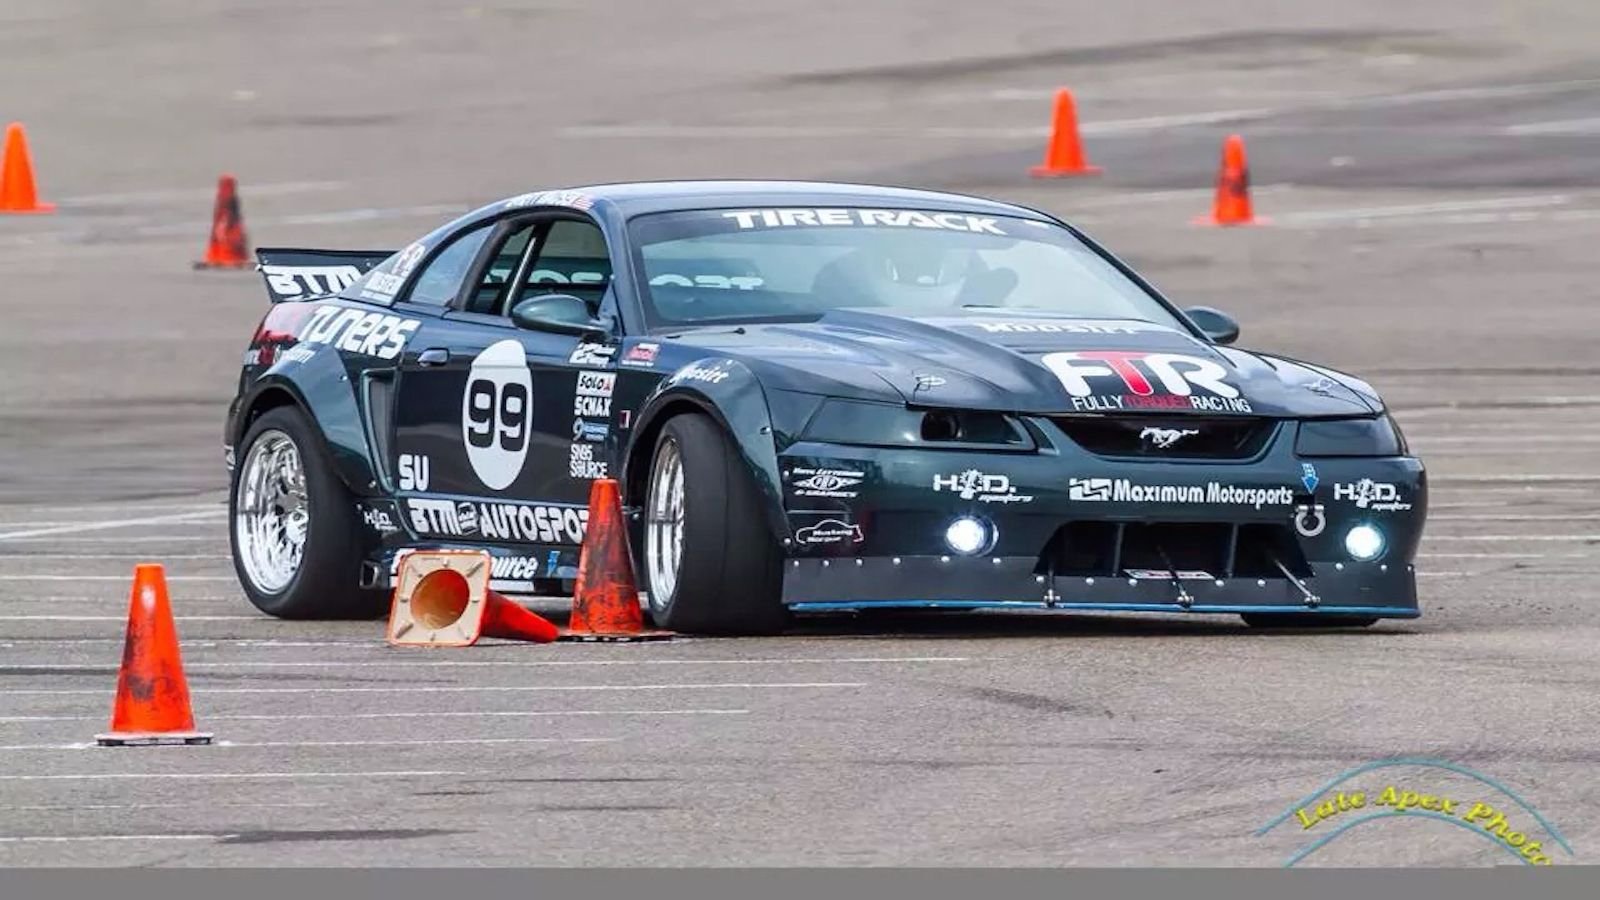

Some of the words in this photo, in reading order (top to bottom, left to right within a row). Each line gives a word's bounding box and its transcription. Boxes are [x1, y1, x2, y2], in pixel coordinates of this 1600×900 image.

[722, 208, 853, 229] TIRE
[857, 210, 1009, 236] RACK
[1040, 351, 1240, 399] FTR
[468, 379, 527, 452] 99
[1070, 395, 1124, 412] FULLY
[1191, 395, 1252, 413] RACING
[398, 453, 430, 492] SU
[1113, 478, 1205, 503] Maximum
[1206, 481, 1293, 510] Motorsports
